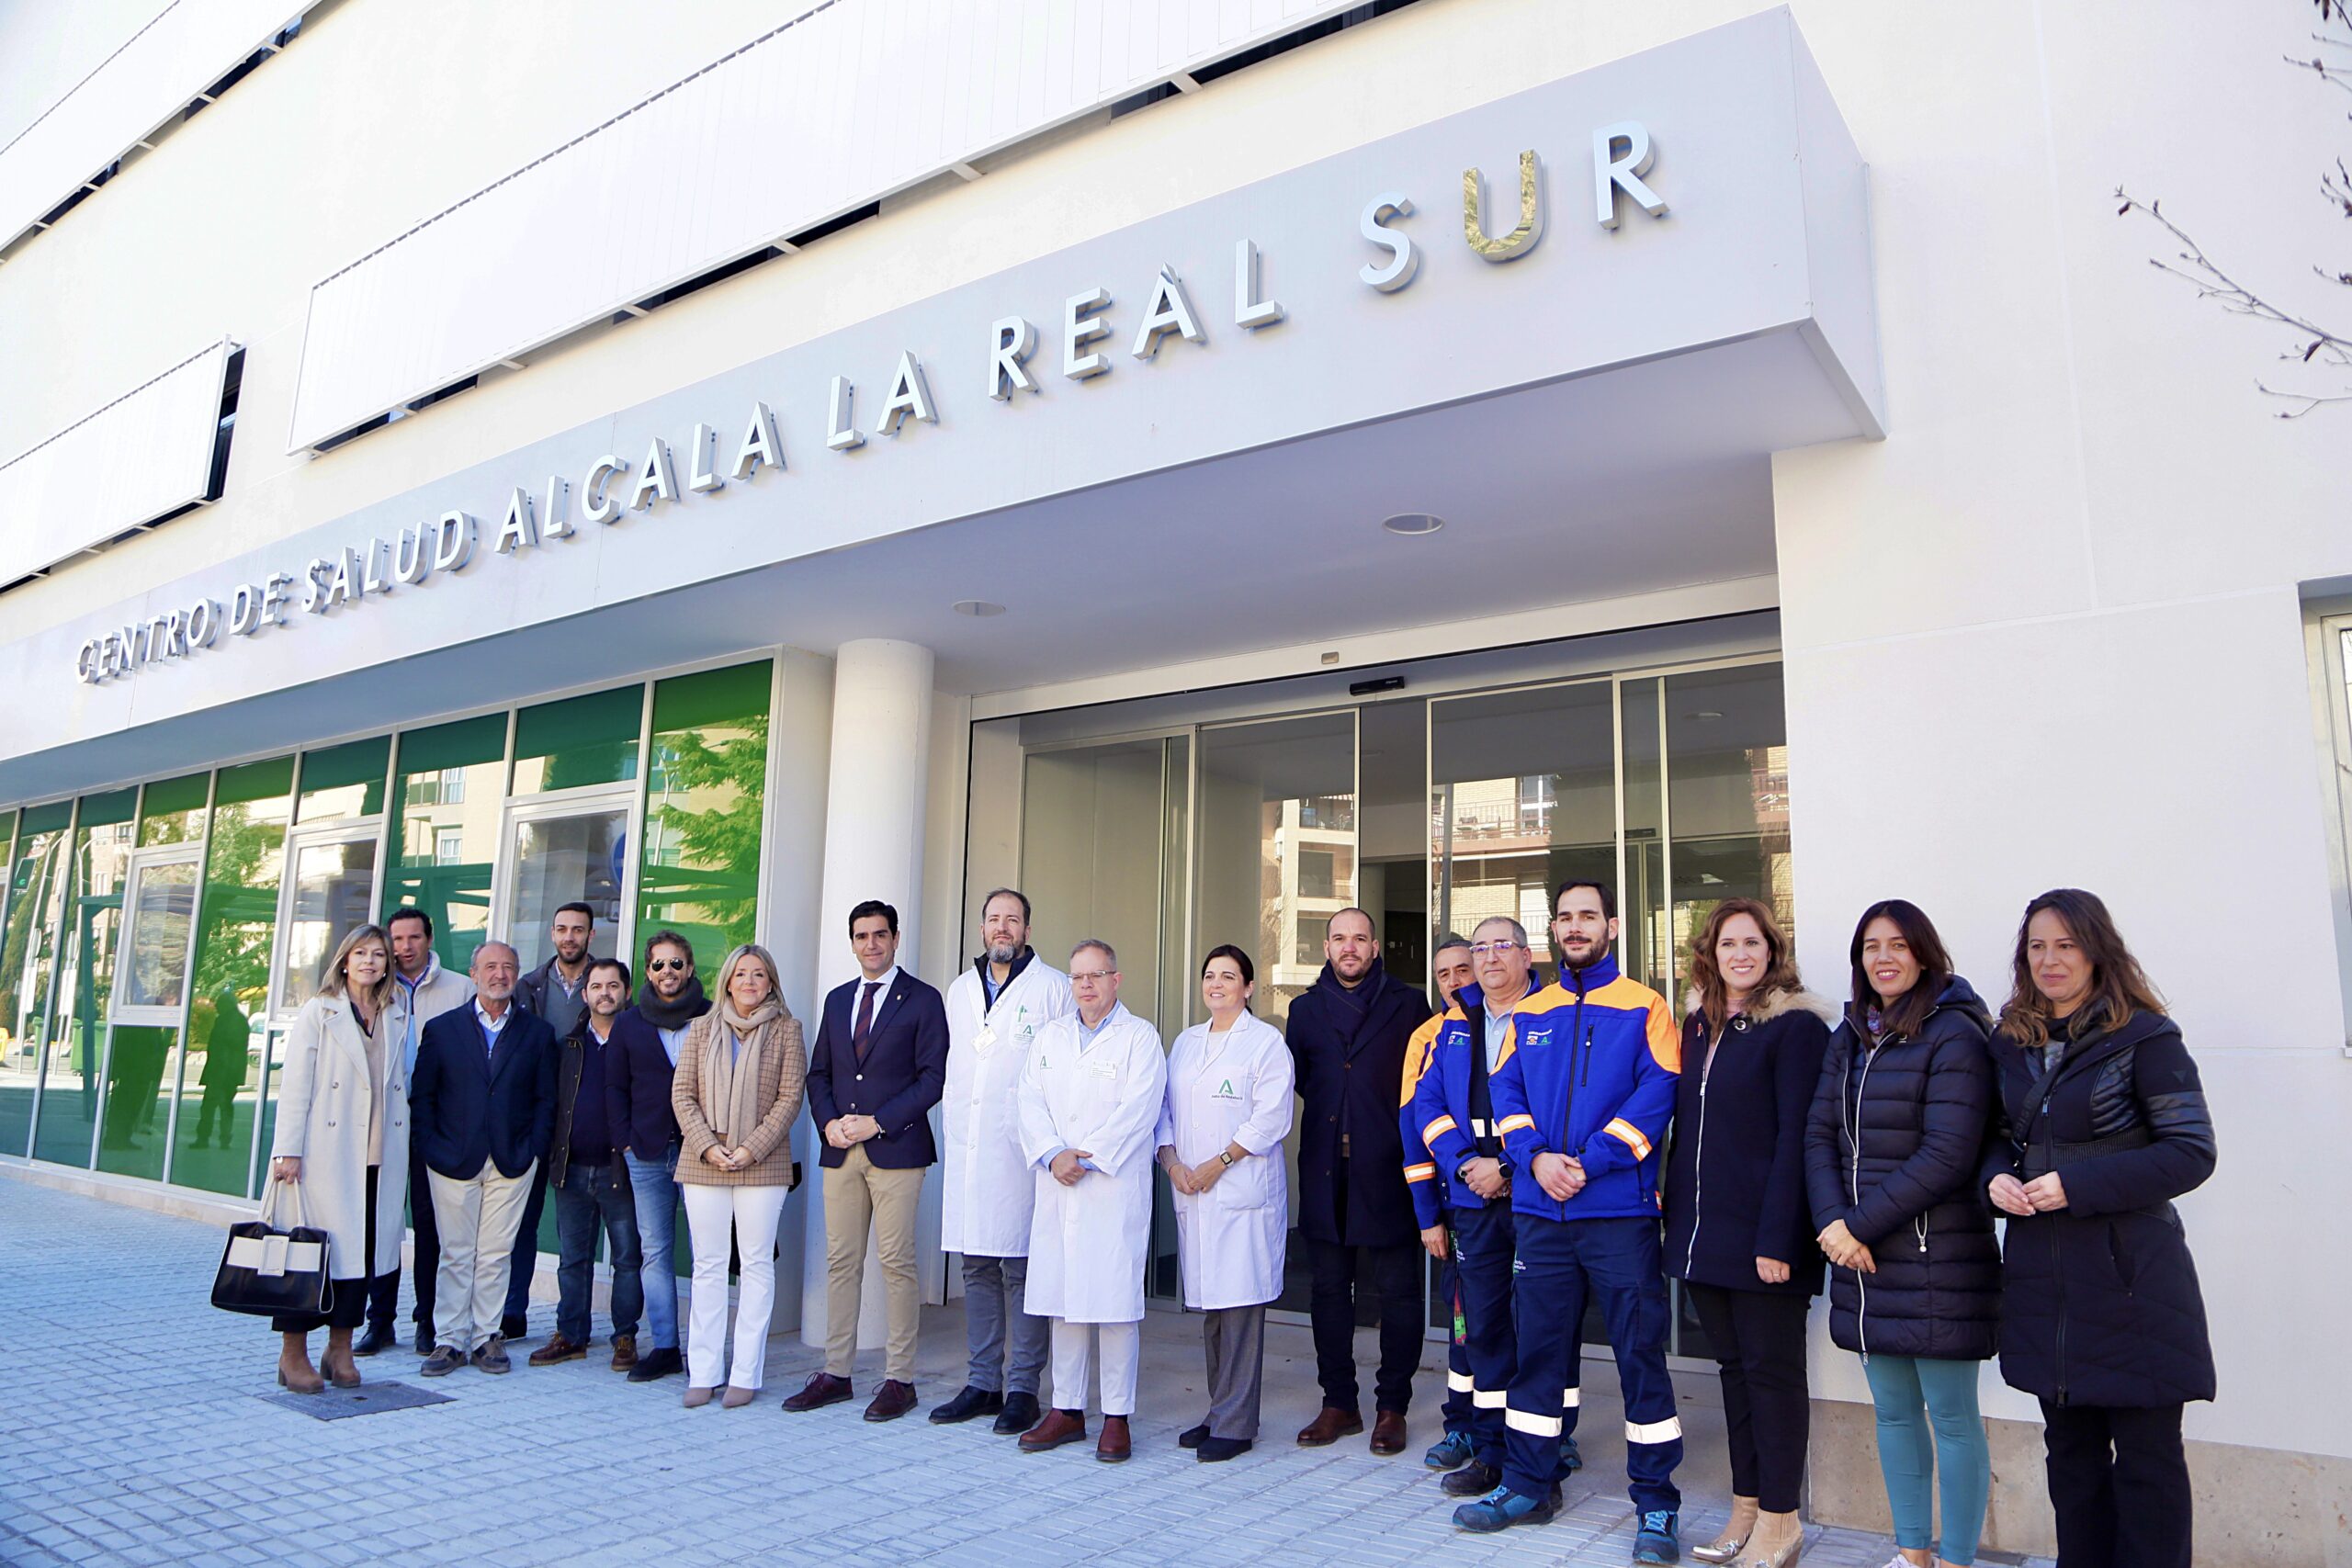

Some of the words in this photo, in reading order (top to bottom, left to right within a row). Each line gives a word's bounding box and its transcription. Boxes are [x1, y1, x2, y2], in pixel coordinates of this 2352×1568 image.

[74, 598, 219, 683] CENTRO
[229, 571, 290, 636] DE
[301, 510, 475, 615] SALUD
[493, 400, 786, 555] ALCALA
[826, 350, 936, 451] LA
[988, 238, 1283, 402] REAL
[1359, 119, 1668, 292] SUR
